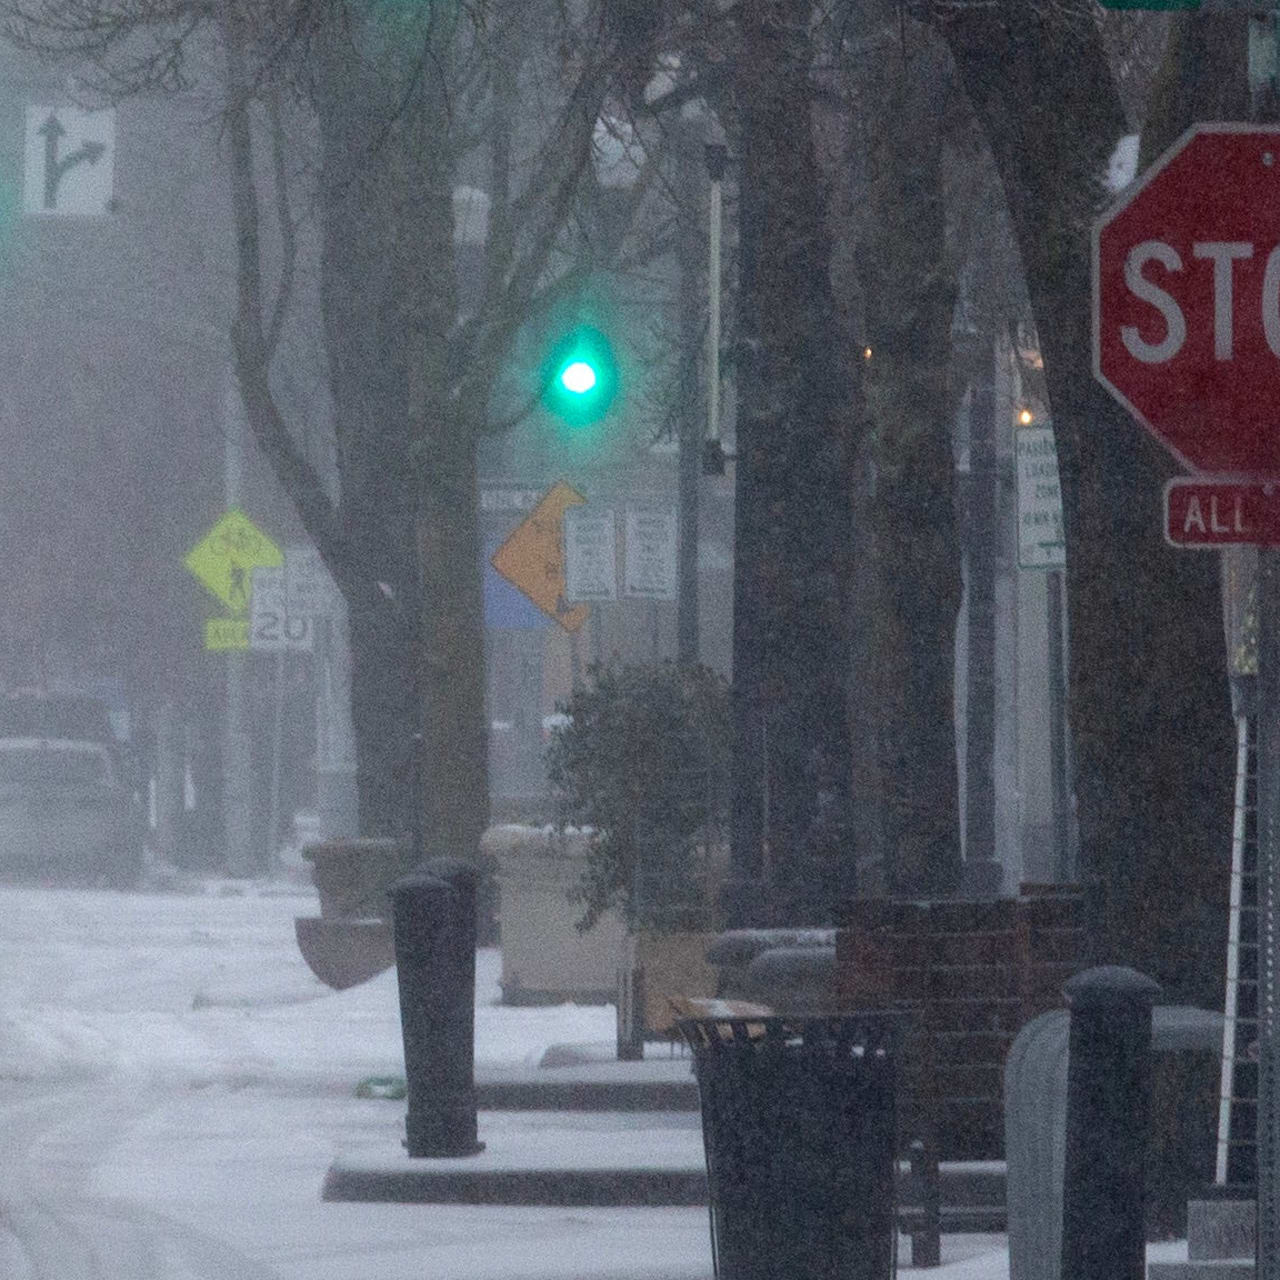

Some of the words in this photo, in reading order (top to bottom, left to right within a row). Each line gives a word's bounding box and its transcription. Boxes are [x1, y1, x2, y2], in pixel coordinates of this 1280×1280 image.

[1120, 240, 1280, 364] ST
[1184, 496, 1245, 532] ALL
[256, 612, 307, 641] 20
